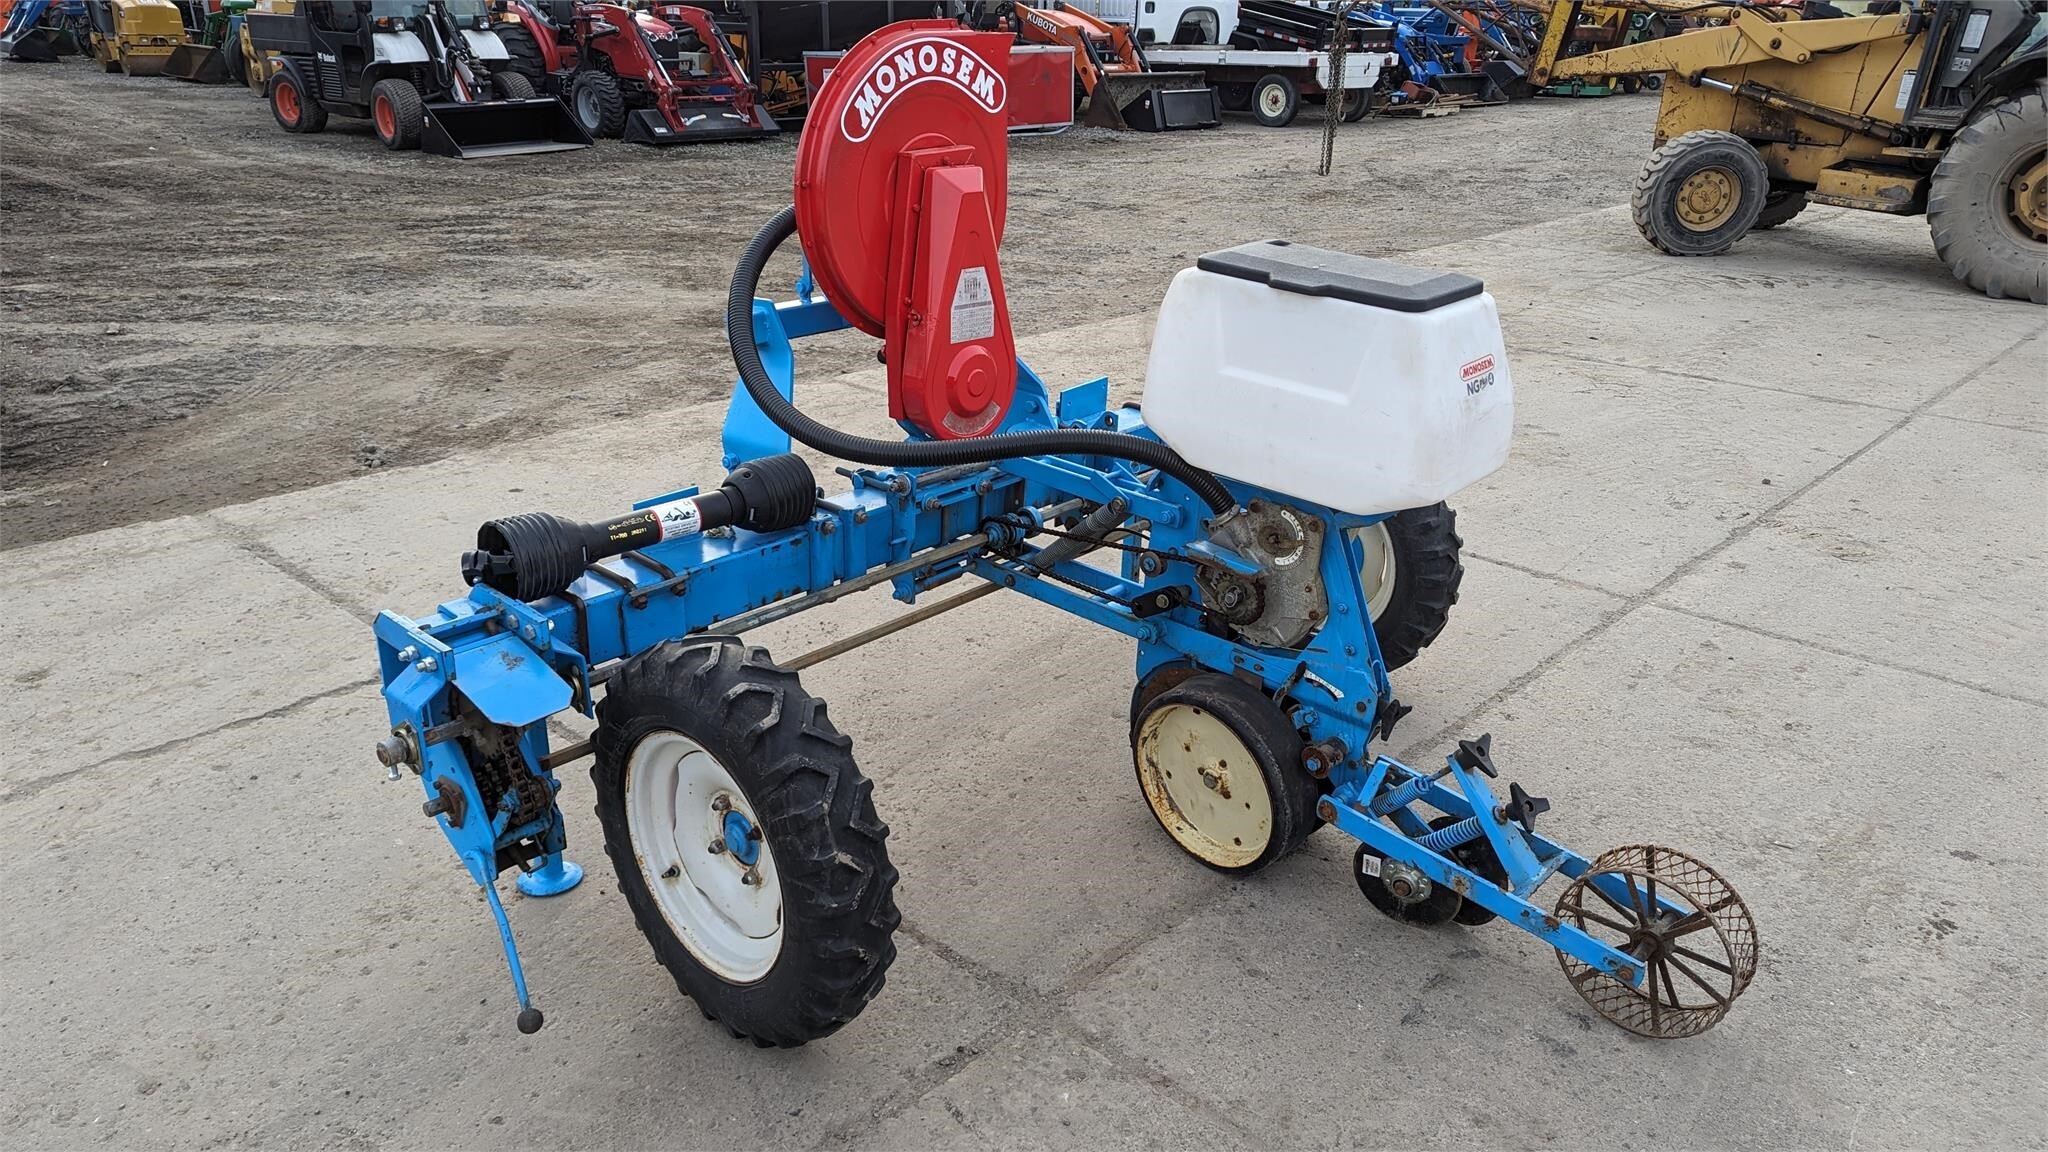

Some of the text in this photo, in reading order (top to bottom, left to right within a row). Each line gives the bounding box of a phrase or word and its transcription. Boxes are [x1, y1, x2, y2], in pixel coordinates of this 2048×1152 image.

[1027, 12, 1057, 35] KUBOTA
[854, 45, 995, 129] MONOSEM
[1463, 358, 1494, 378] MONOSEM
